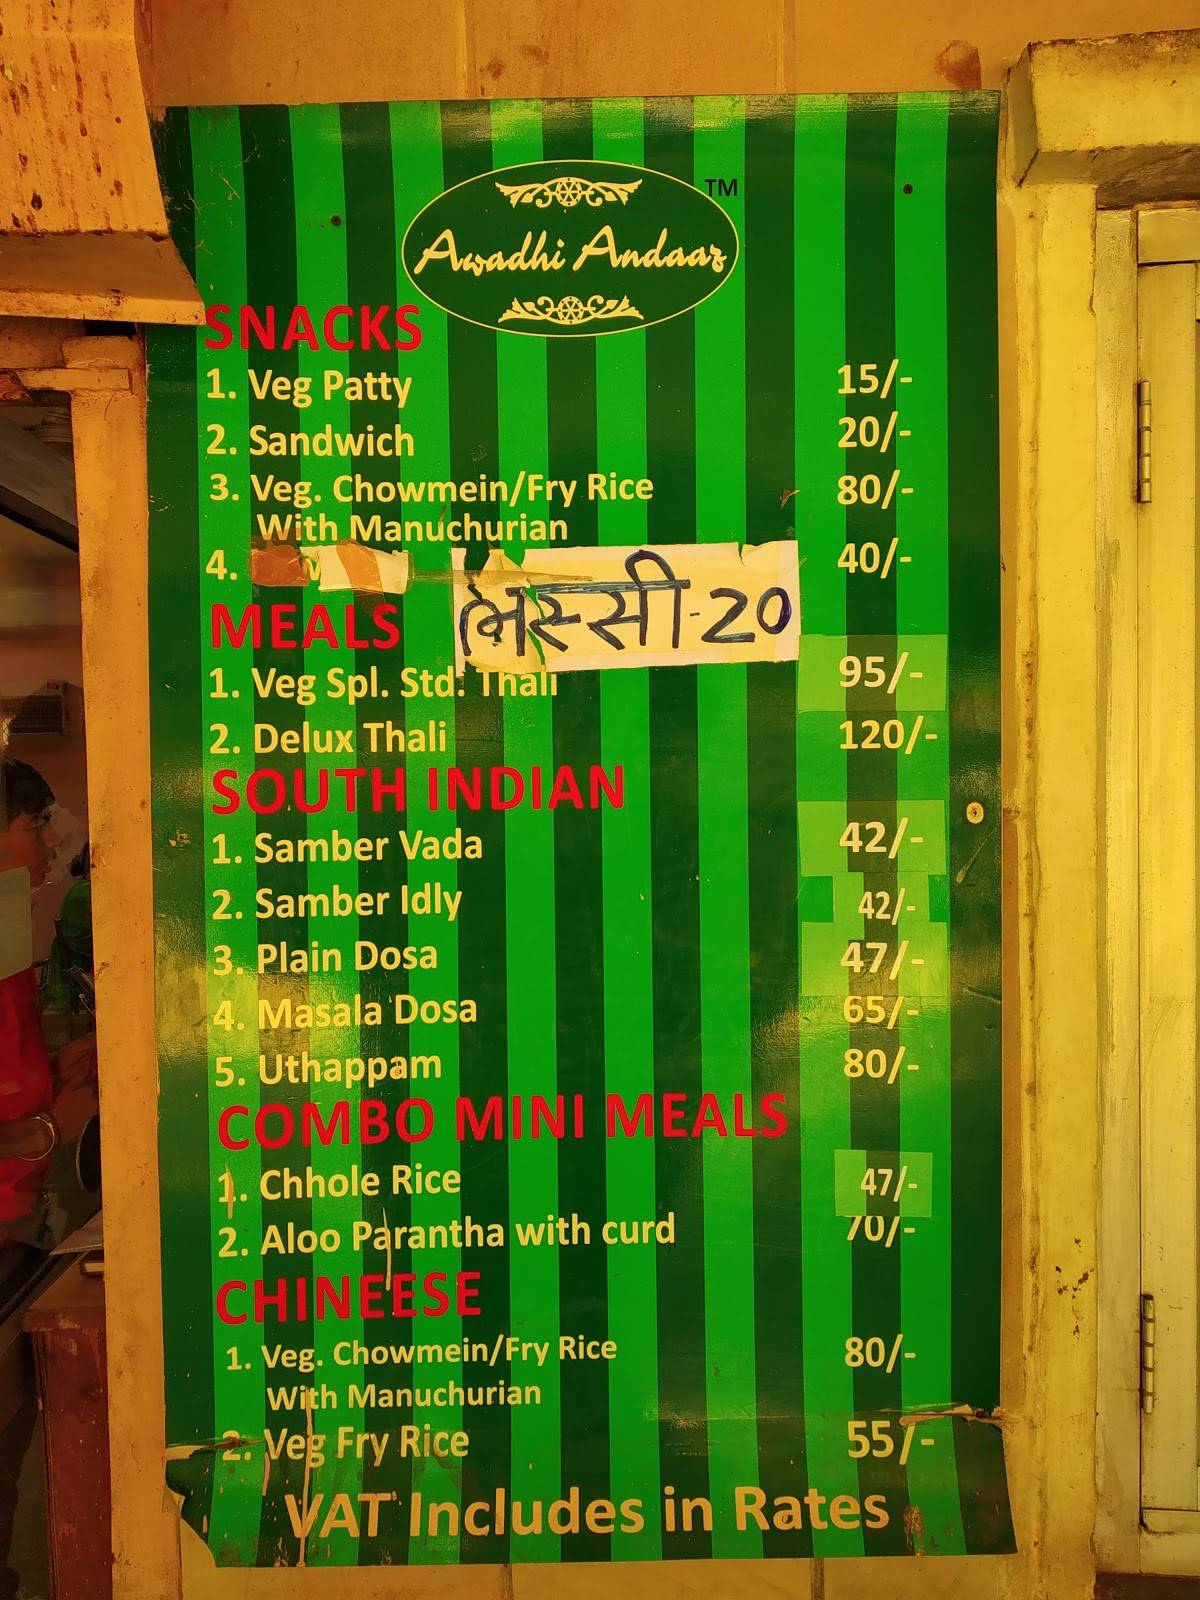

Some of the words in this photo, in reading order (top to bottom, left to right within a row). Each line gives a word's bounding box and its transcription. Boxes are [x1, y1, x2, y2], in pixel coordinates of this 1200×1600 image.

[704, 178, 739, 198] TM
[413, 228, 566, 277] Awadhi
[572, 225, 728, 273] Andaaz
[204, 304, 422, 351] SNACKS
[207, 368, 236, 399] 1.
[247, 369, 313, 408] Veg
[324, 370, 412, 409] Patty
[838, 358, 913, 399] 15/-
[206, 423, 237, 455] 2.
[249, 423, 414, 457] Sandwich
[838, 411, 911, 453] 20/-
[210, 473, 239, 501] 3.
[250, 474, 321, 509] Veg.
[333, 470, 577, 508] Chowmein/Fry
[588, 472, 654, 500] Rice
[837, 469, 914, 510] 80/-
[255, 511, 340, 543] With
[350, 509, 572, 543] Manuchurian
[205, 549, 238, 580] 4.
[837, 537, 912, 579] 40/-
[211, 603, 400, 649] MEALS
[210, 667, 240, 698] 1.
[251, 667, 316, 706] Veg
[327, 665, 389, 705] Spl.
[396, 664, 468, 700] Std.
[481, 671, 558, 697] Thali
[838, 651, 923, 695] 95/-
[209, 723, 241, 754] 2.
[254, 721, 354, 754] Delux
[363, 720, 446, 753] Thali
[839, 715, 938, 755] 120/-
[212, 767, 405, 815] SOUTH
[428, 765, 624, 811] INDIAN
[211, 832, 243, 866] 1.
[254, 829, 389, 864] Samber
[398, 827, 482, 860] Vada
[838, 817, 925, 860] 42/-
[211, 889, 244, 921] 2.
[255, 884, 390, 919] Samber
[401, 882, 463, 921] Idly
[858, 888, 917, 925] 42/-
[211, 944, 245, 977] 3.
[255, 938, 345, 976] Plain
[355, 940, 437, 971] Dosa
[840, 940, 925, 980] 47/-
[211, 999, 246, 1032] 4.
[257, 993, 383, 1031] Masala
[395, 994, 477, 1025] Dosa
[842, 996, 920, 1030] 65/-
[212, 1055, 247, 1088] 5.
[257, 1052, 444, 1090] Uthappam
[842, 1046, 920, 1084] 80/-
[218, 1098, 434, 1150] COMBO
[455, 1094, 584, 1141] MINI
[607, 1092, 788, 1138] MEALS
[217, 1171, 248, 1203] 1.
[259, 1164, 380, 1200] Chhole
[392, 1163, 461, 1195] Rice
[860, 1166, 918, 1202] 47/-
[218, 1227, 248, 1257] 2.
[260, 1222, 341, 1255] Aloo
[351, 1216, 507, 1252] Parantha
[515, 1213, 590, 1246] with
[602, 1211, 675, 1244] curd
[216, 1271, 481, 1324] CHINEESE
[227, 1347, 251, 1370] 1.
[261, 1344, 323, 1373] Veg.
[333, 1334, 549, 1366] Chowmein/Fry
[559, 1334, 617, 1360] Rice
[845, 1333, 916, 1373] 80/-
[267, 1385, 337, 1411] With
[348, 1380, 541, 1408] Manuchurian
[263, 1428, 326, 1469] Veg
[337, 1426, 389, 1466] Fry
[400, 1423, 469, 1458] Rice
[846, 1419, 935, 1466] 55/-
[285, 1493, 391, 1539] VAT
[410, 1487, 644, 1537] Includes
[664, 1486, 713, 1532] in
[735, 1486, 889, 1531] Rates
